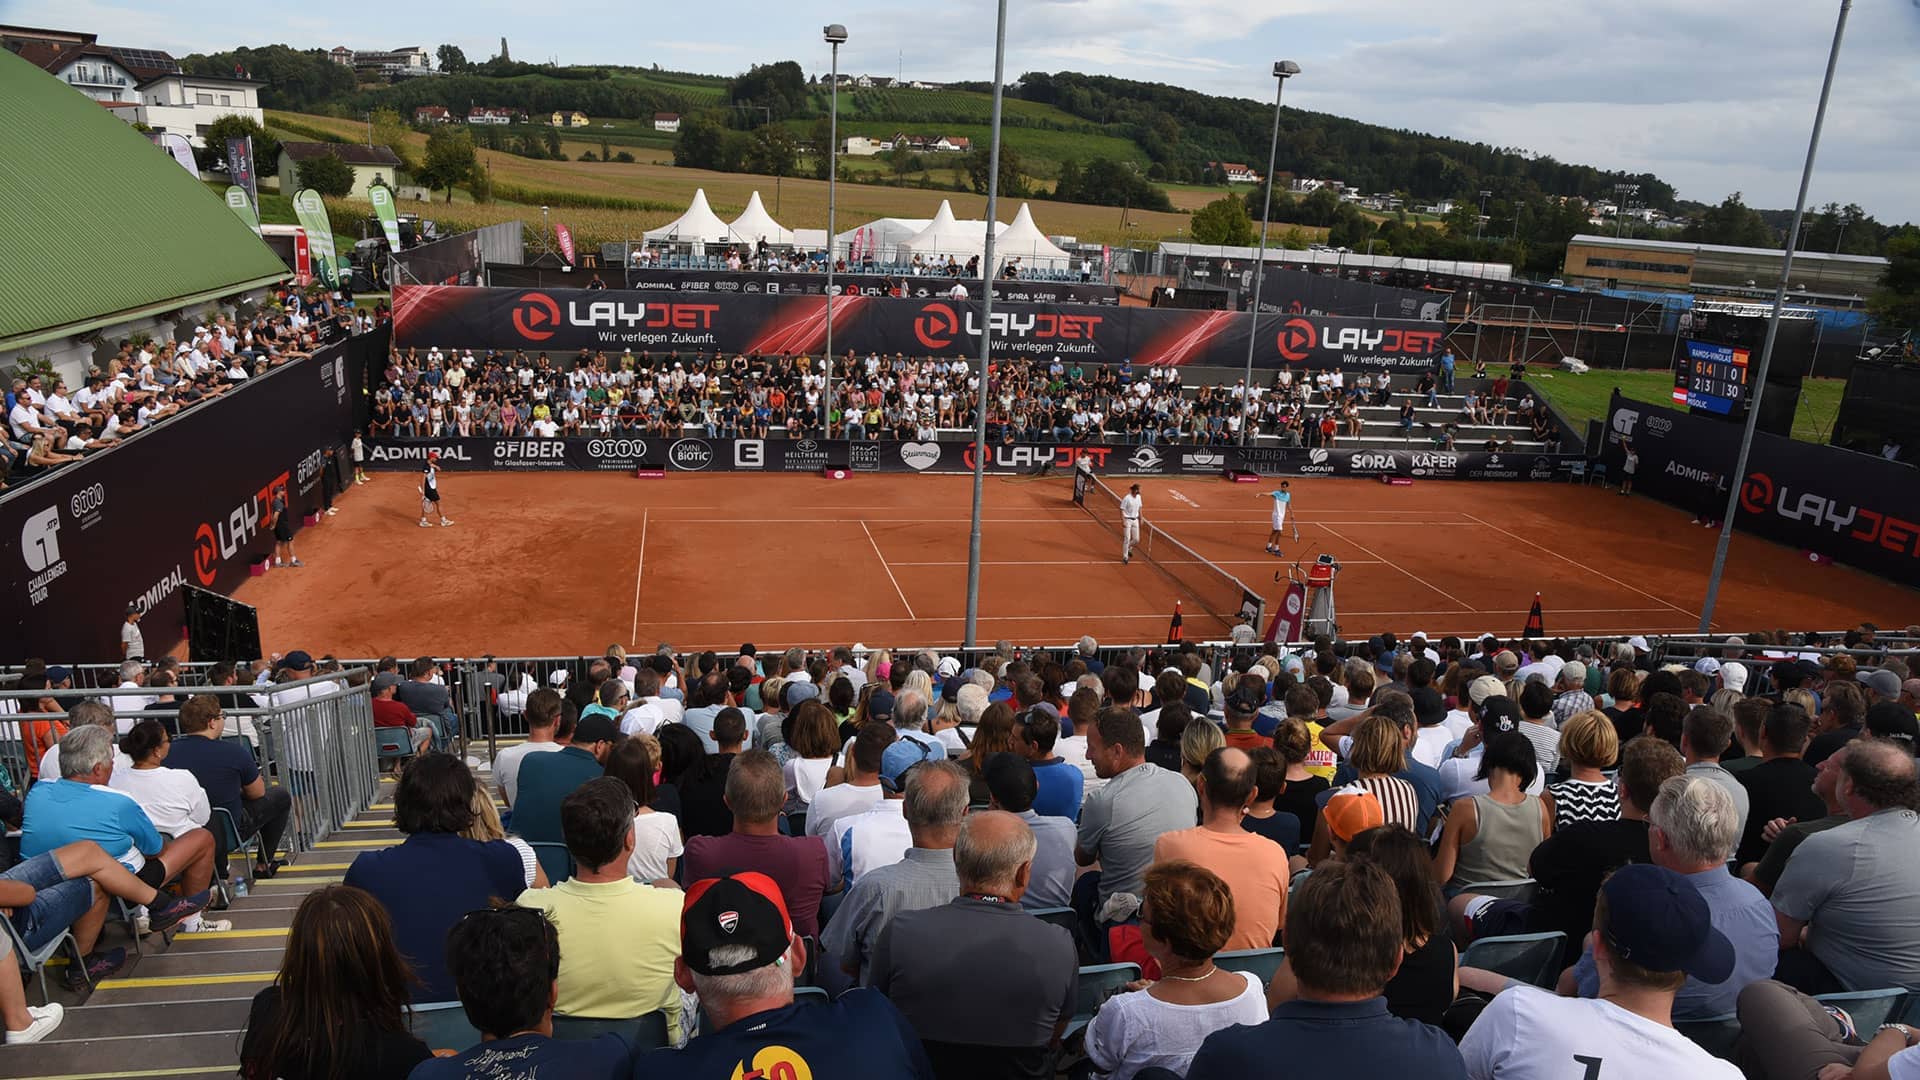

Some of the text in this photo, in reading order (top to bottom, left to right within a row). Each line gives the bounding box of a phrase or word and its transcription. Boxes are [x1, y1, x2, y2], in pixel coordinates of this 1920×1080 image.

[636, 281, 676, 290] ADMIRAL
[598, 331, 717, 346] Wir verlegen Zukunft.
[991, 340, 1097, 354] Wir verlegen Zukunft.
[1343, 354, 1435, 368] Wir verlegen Zukunft.
[1695, 361, 1738, 380] 6 4 0
[1694, 378, 1738, 398] 2 3 30
[494, 441, 566, 458] öFIBER
[587, 439, 647, 457] STTV
[1238, 449, 1288, 461] STEIRER
[1351, 454, 1397, 469] SORA
[1411, 453, 1457, 468] KÄFER
[1665, 460, 1727, 491] ADMIRL
[28, 560, 67, 594] CHALLENGER
[30, 586, 49, 607] TOUR
[128, 564, 187, 622] DMIRAL
